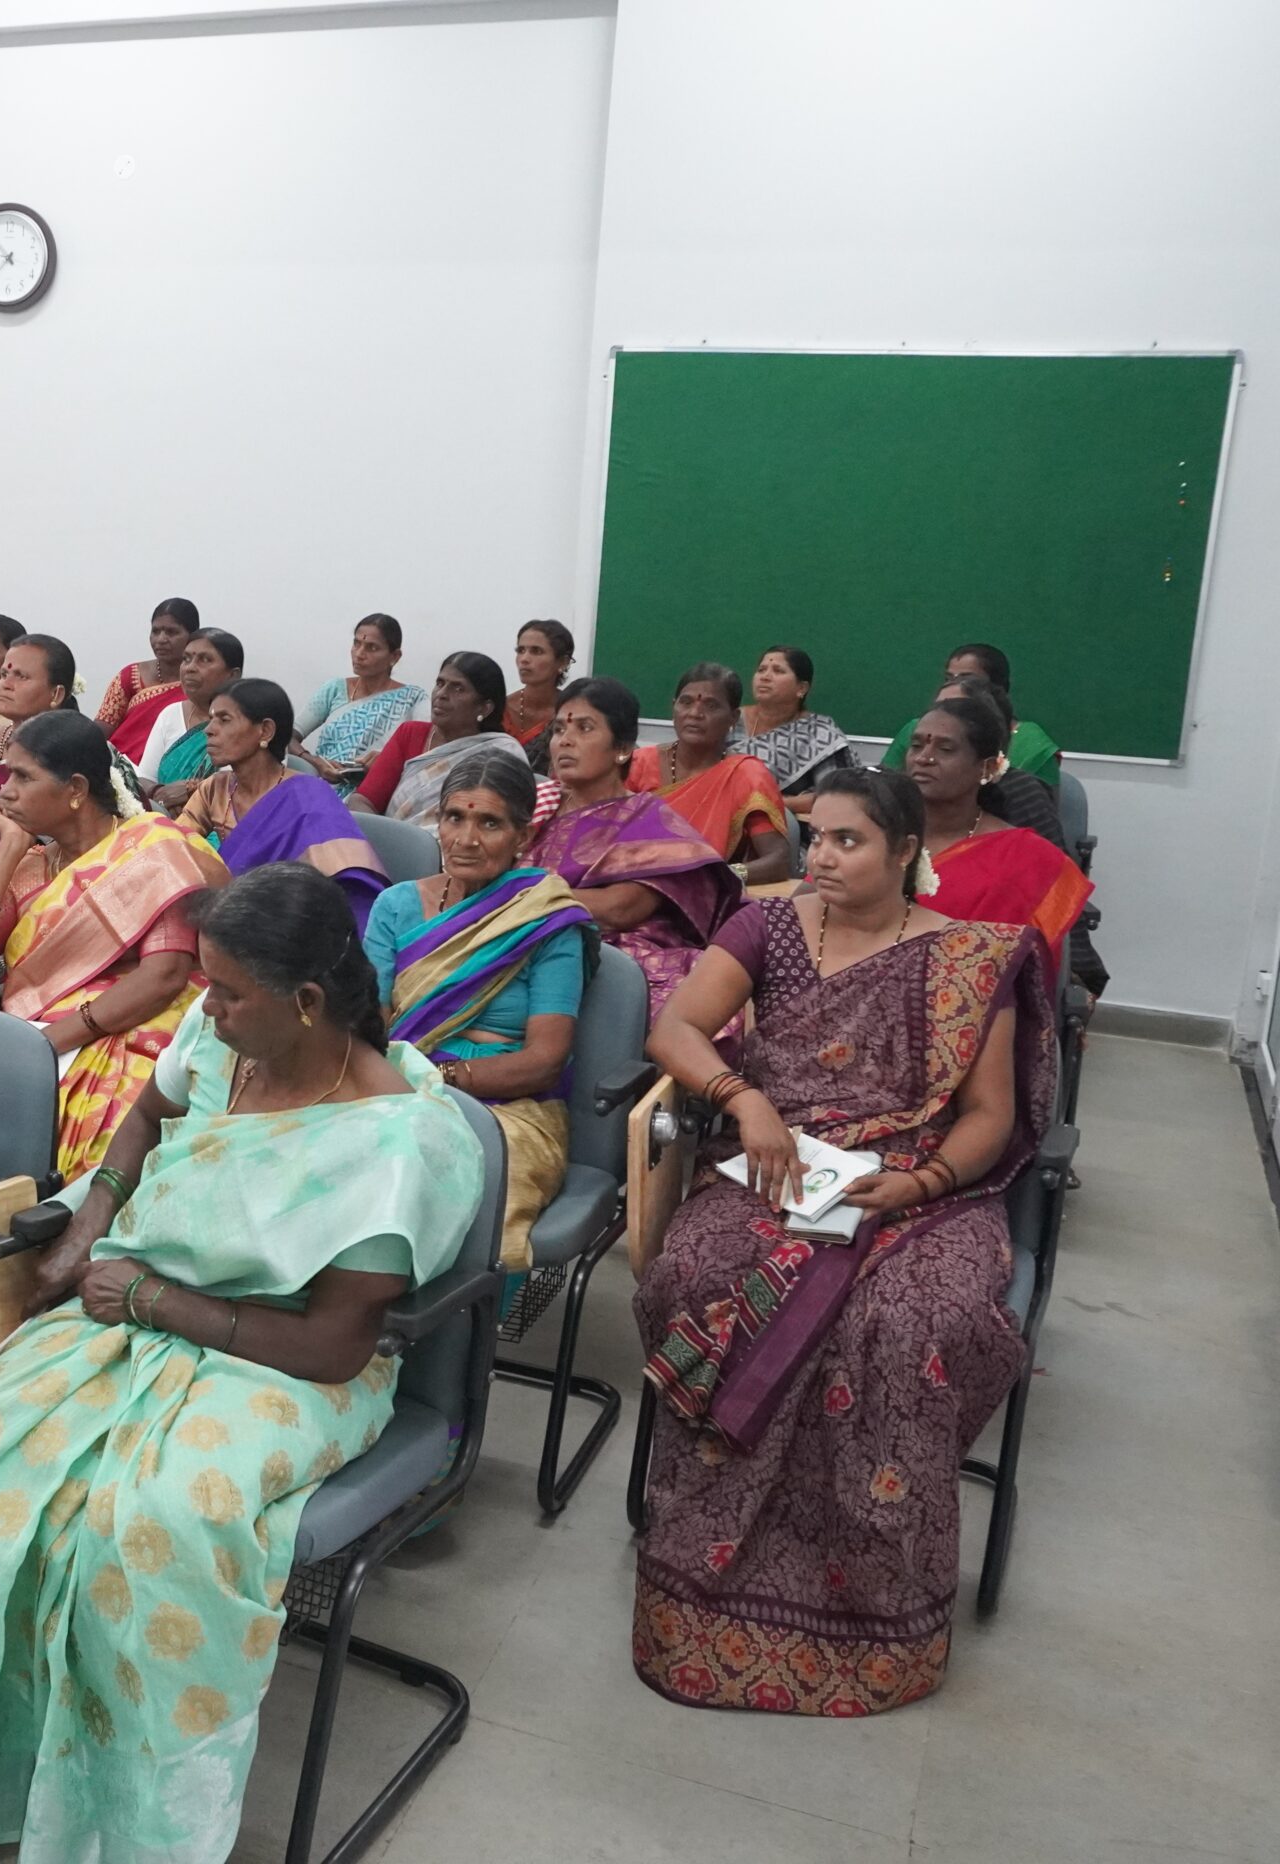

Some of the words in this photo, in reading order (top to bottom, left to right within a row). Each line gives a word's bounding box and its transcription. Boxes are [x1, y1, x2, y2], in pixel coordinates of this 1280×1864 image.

[6, 220, 14, 233] 12
[30, 236, 36, 249] 2
[28, 268, 34, 279] 4
[5, 284, 11, 295] 6
